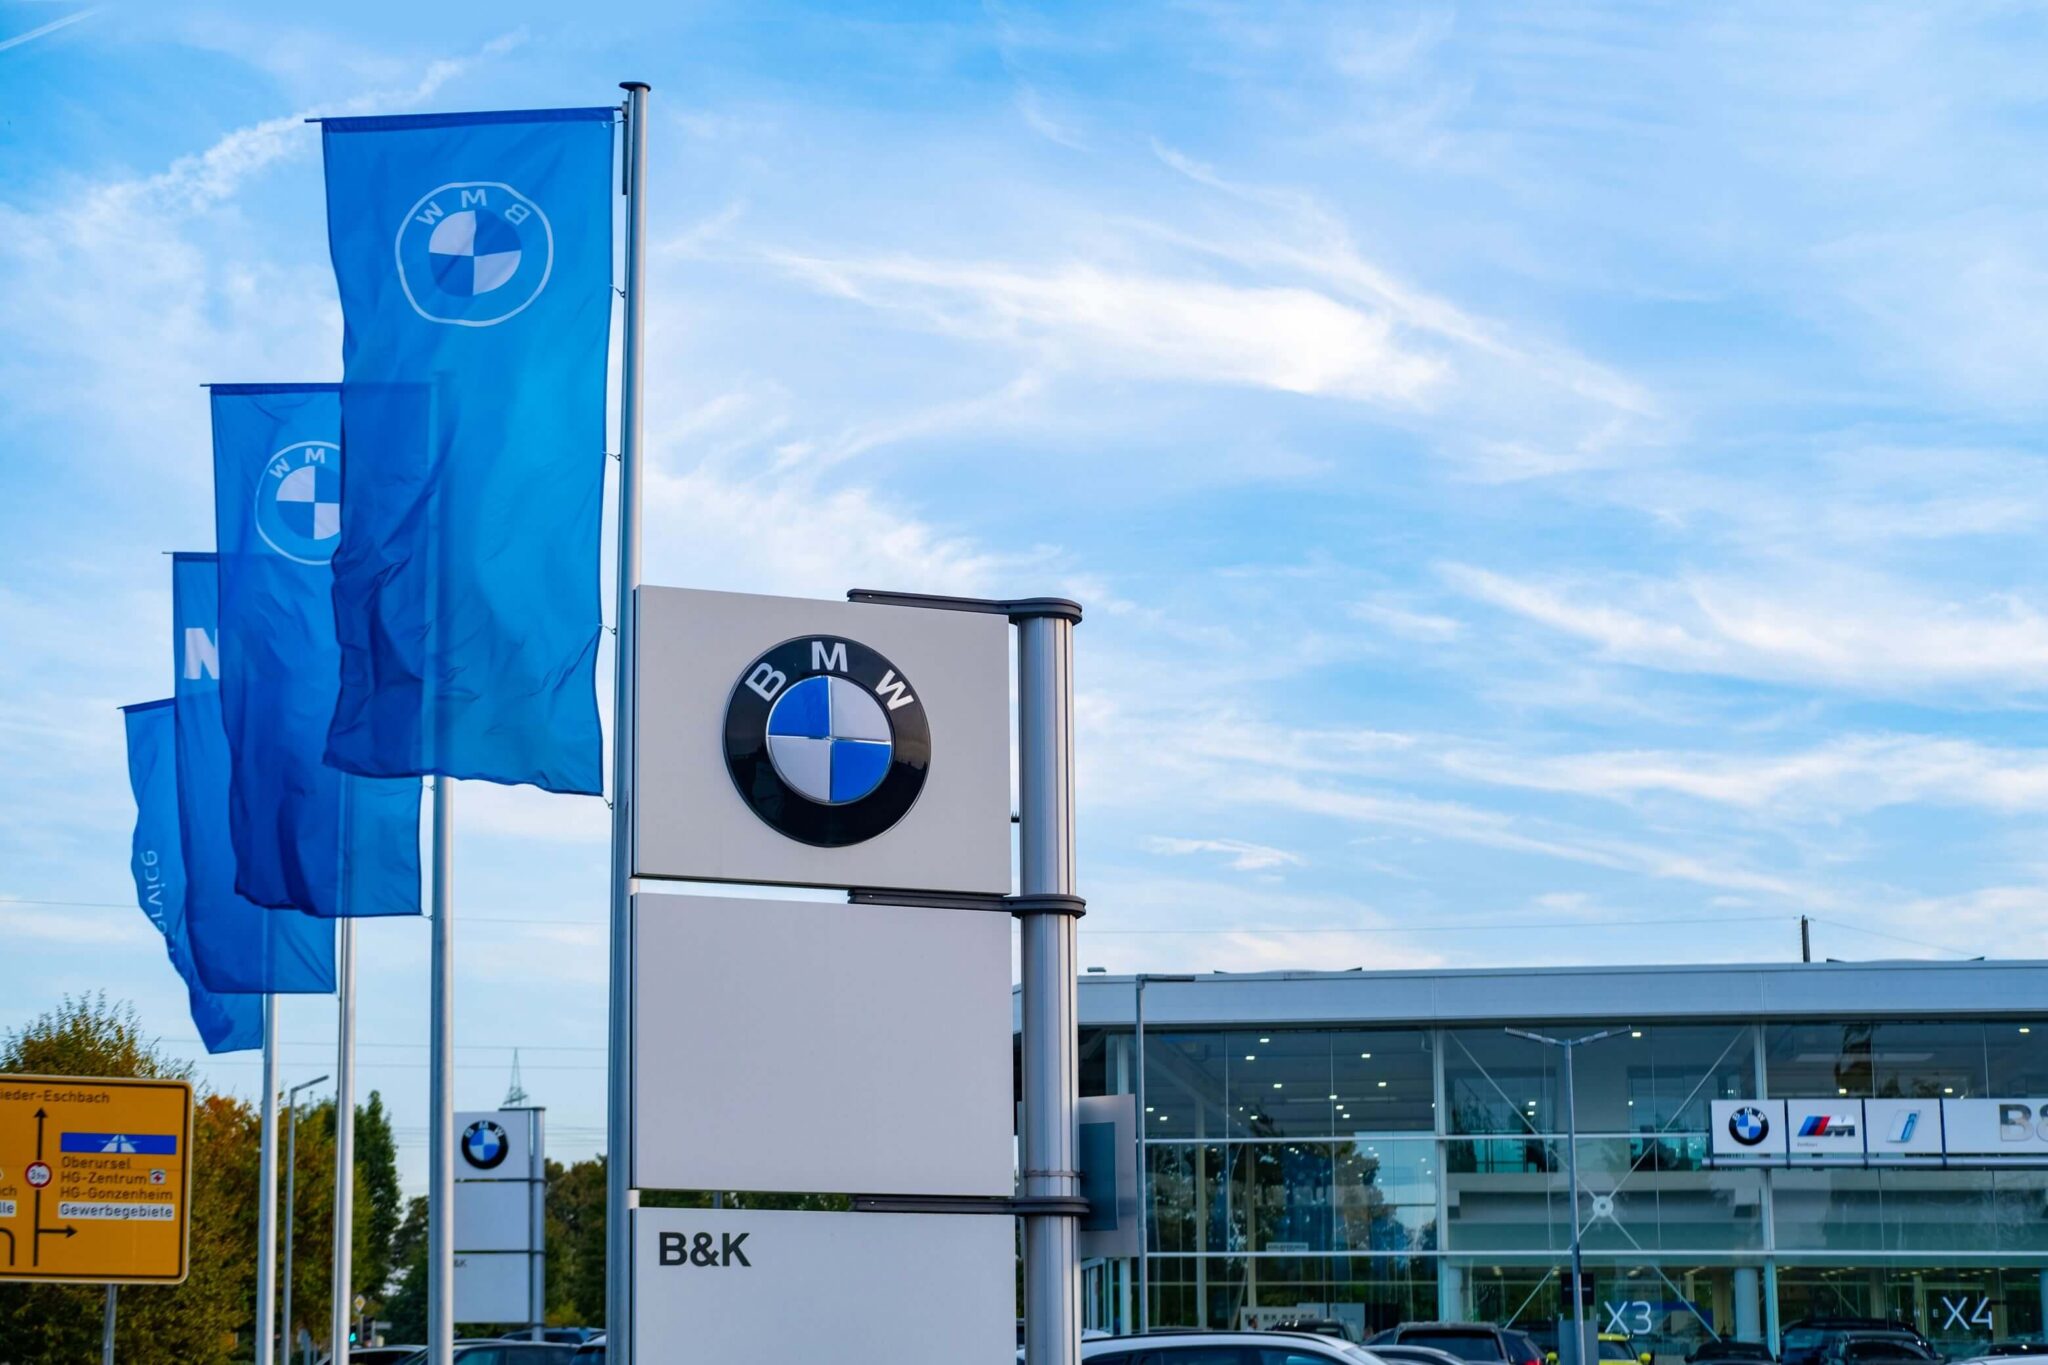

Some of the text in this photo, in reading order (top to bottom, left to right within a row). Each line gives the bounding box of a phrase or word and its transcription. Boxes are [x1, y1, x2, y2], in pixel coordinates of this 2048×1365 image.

[744, 640, 915, 712] BMW
[0, 1088, 110, 1104] ieder-Eschbach
[61, 1156, 131, 1169] Oberursel
[60, 1171, 147, 1184] HG-Zentrum
[60, 1186, 173, 1200] HG-Gonzenheim
[60, 1203, 173, 1220] Gewerbegebiete
[657, 1231, 752, 1268] B&K
[1603, 1300, 1653, 1335] X3
[1942, 1296, 1994, 1330] X4
